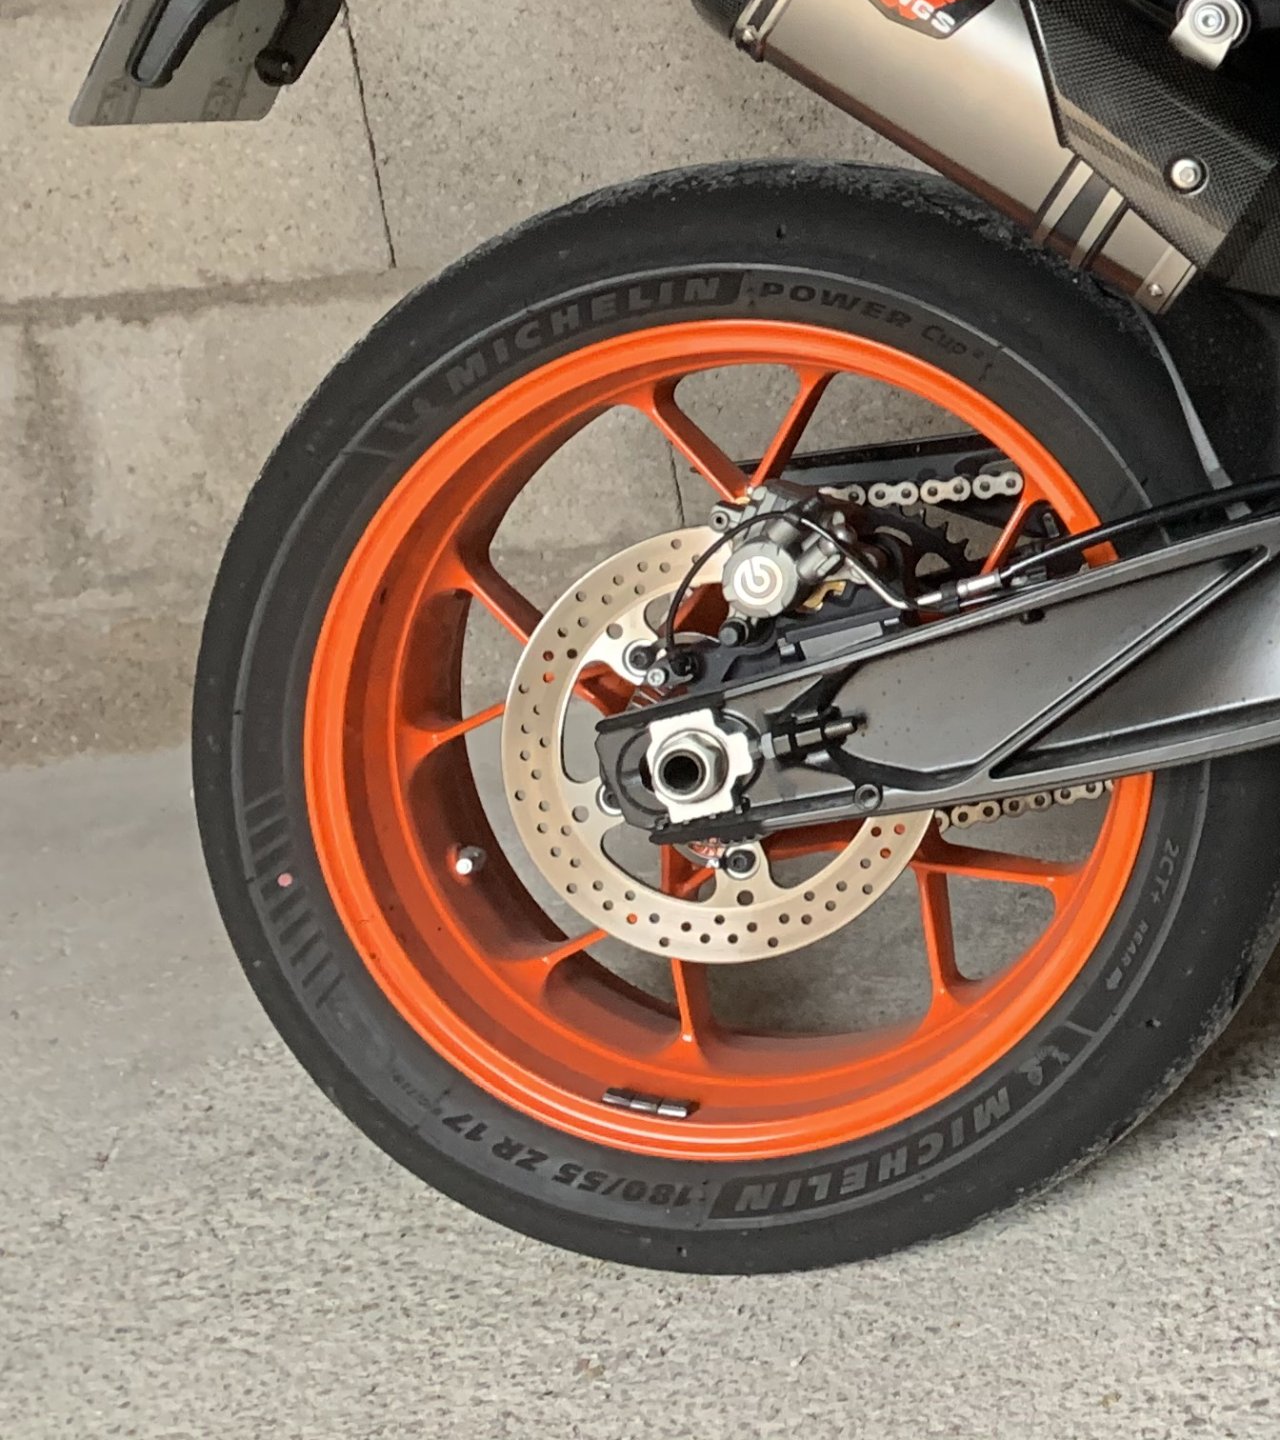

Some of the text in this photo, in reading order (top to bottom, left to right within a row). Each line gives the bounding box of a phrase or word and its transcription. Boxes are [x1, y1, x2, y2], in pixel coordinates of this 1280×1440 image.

[446, 276, 719, 393] MICHELIN
[759, 281, 912, 329] POWER
[1121, 919, 1149, 967] REAR
[441, 1112, 694, 1208] 180/55 ZR 17
[734, 1086, 1010, 1212] MICHELIN
